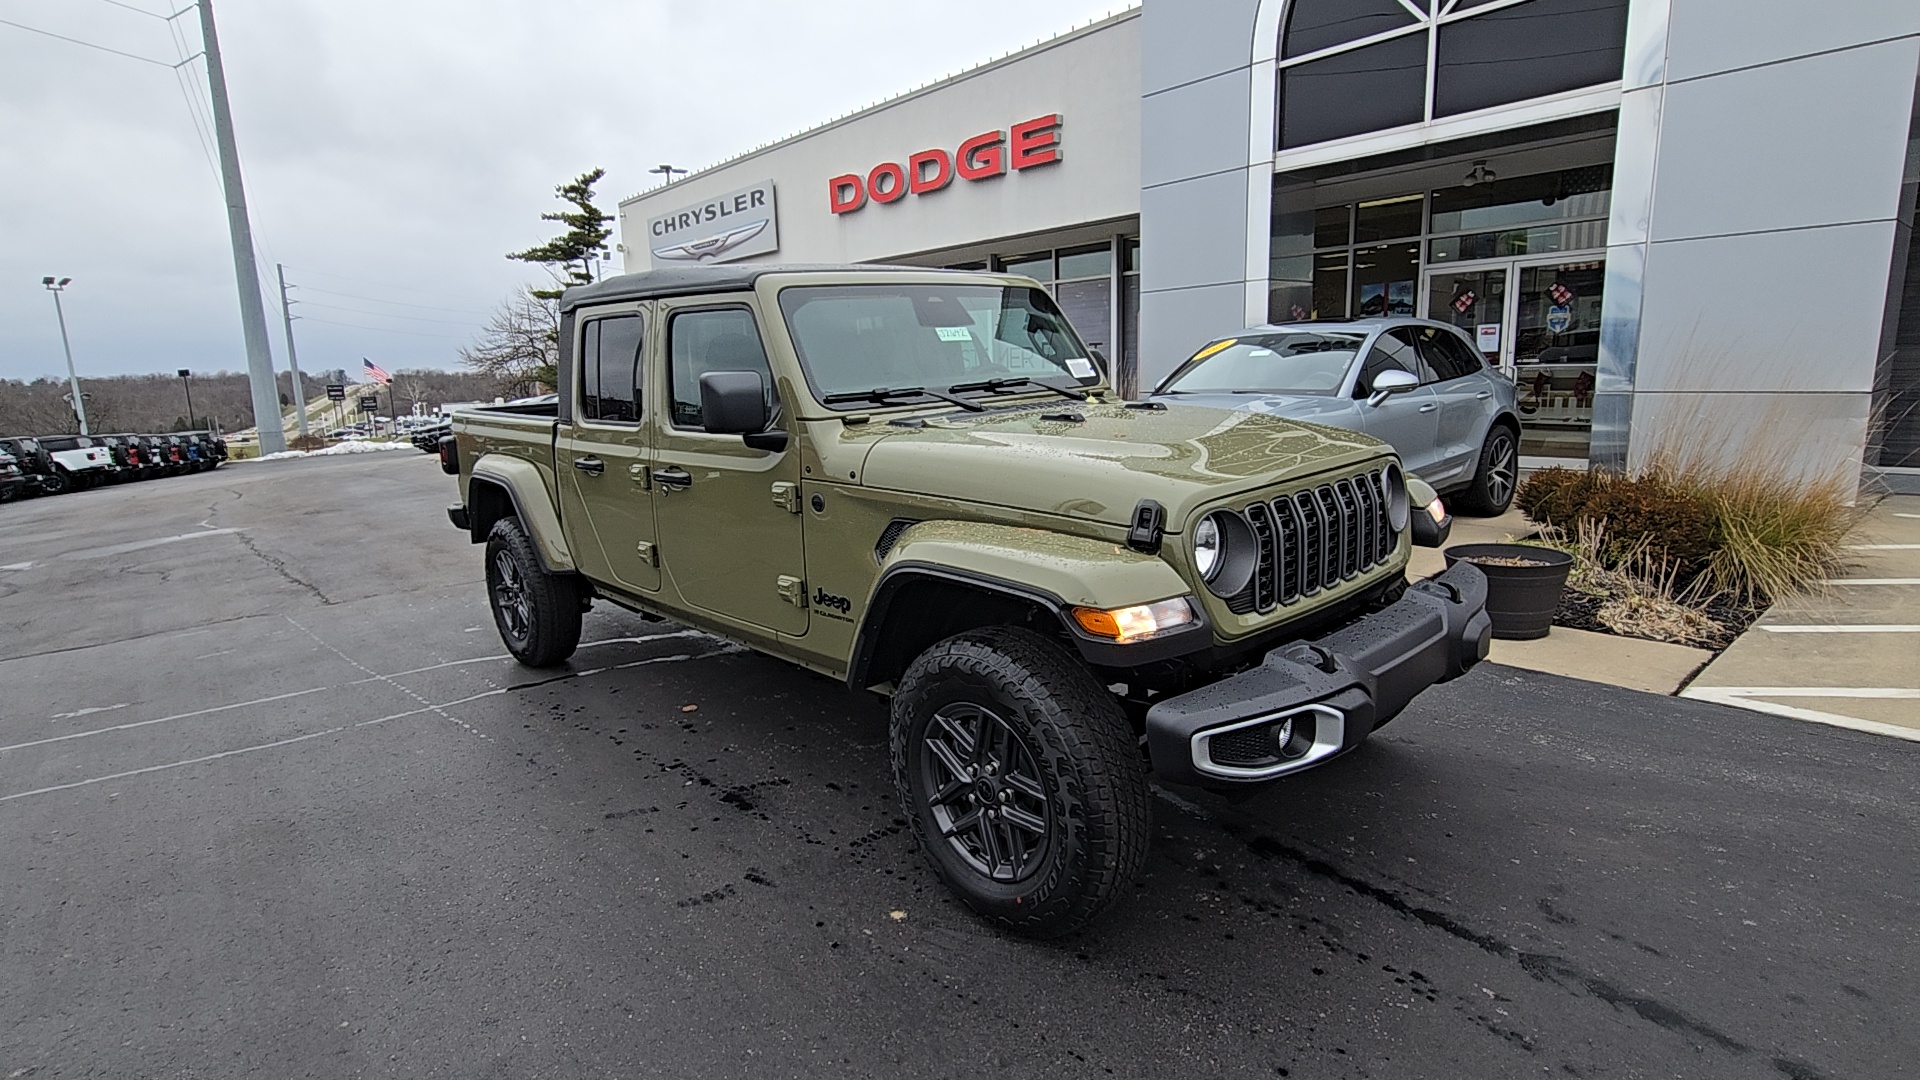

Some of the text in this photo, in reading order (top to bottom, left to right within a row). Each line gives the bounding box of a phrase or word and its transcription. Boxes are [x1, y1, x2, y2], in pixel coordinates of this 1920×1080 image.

[828, 113, 1061, 216] DODGE
[651, 189, 767, 237] CHRYSLER
[813, 588, 851, 614] Jeep
